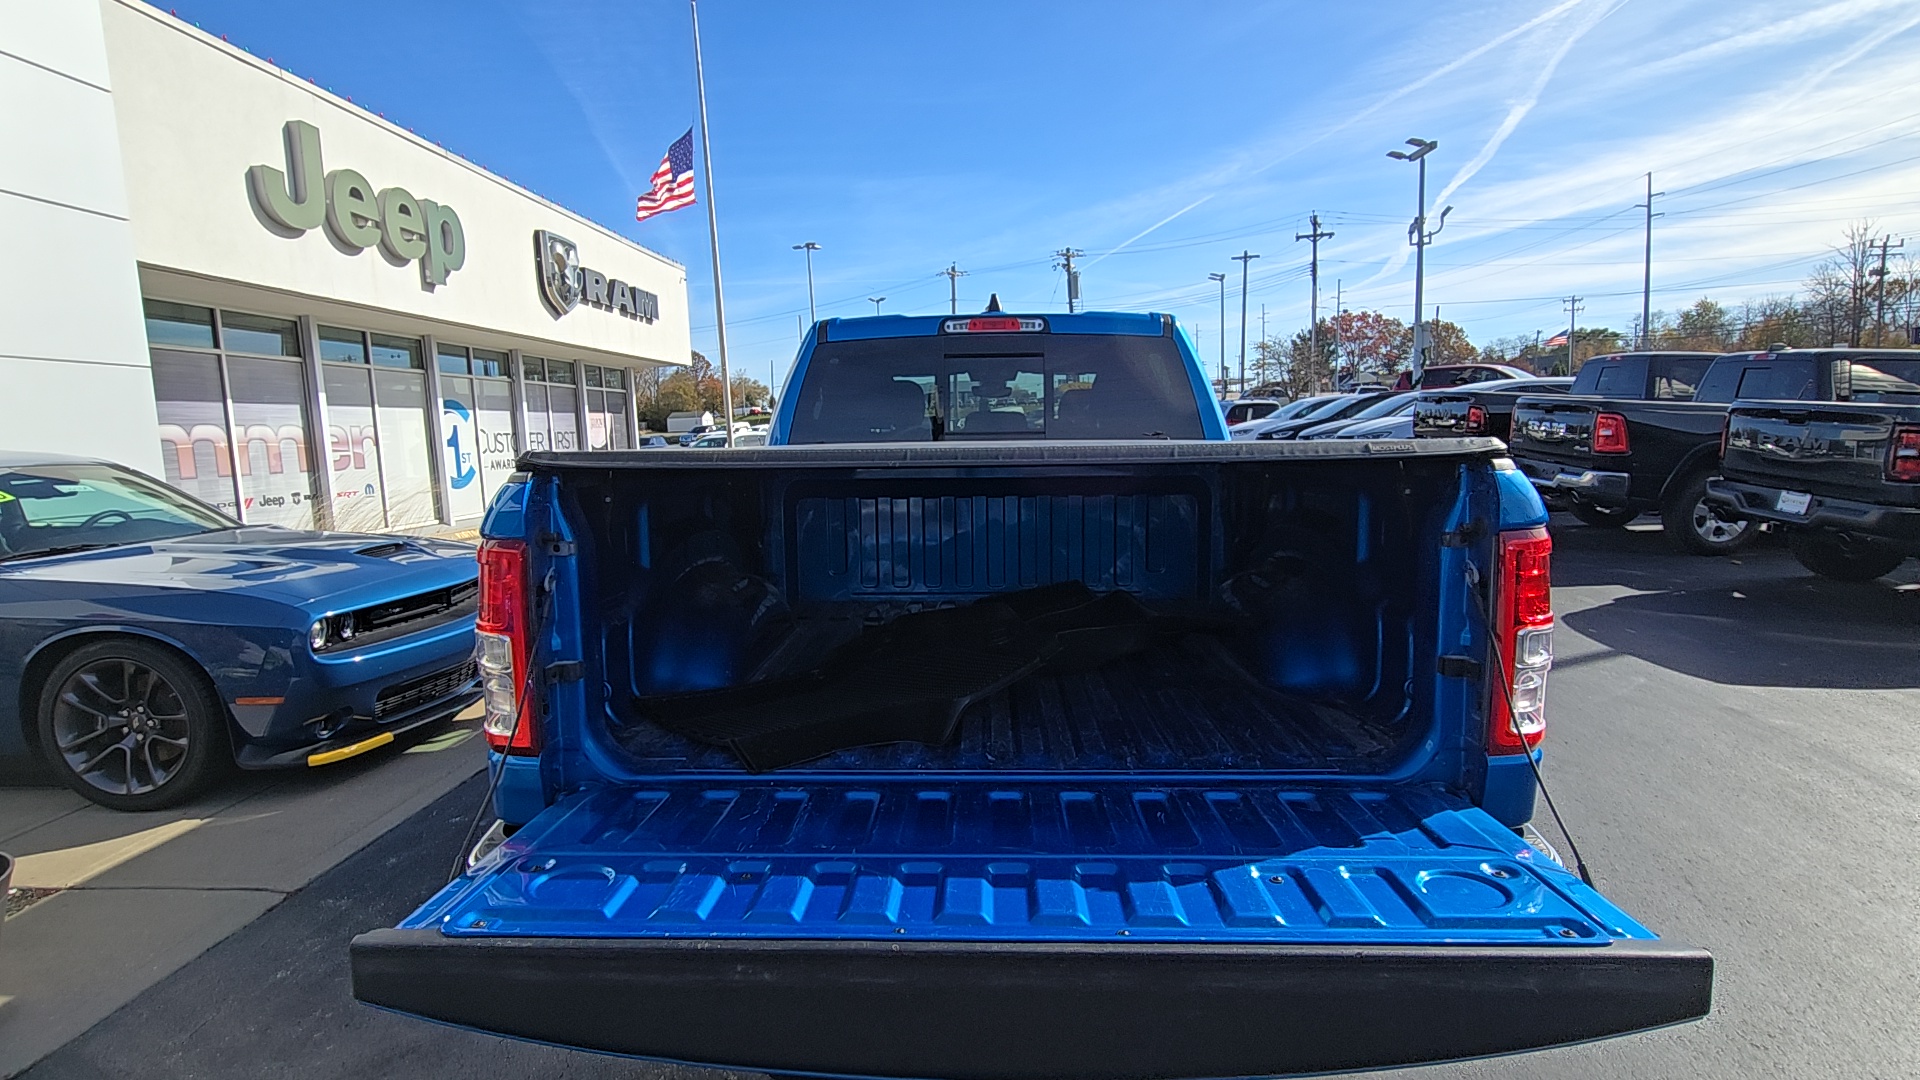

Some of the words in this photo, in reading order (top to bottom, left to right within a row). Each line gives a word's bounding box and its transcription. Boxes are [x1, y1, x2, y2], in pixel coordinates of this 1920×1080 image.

[246, 120, 465, 290] Jeep
[580, 267, 659, 322] RAM
[1528, 420, 1566, 435] RAM
[480, 429, 546, 454] USTOER
[551, 430, 576, 450] IRST
[1758, 433, 1830, 454] RAM
[259, 495, 285, 508] Jeep
